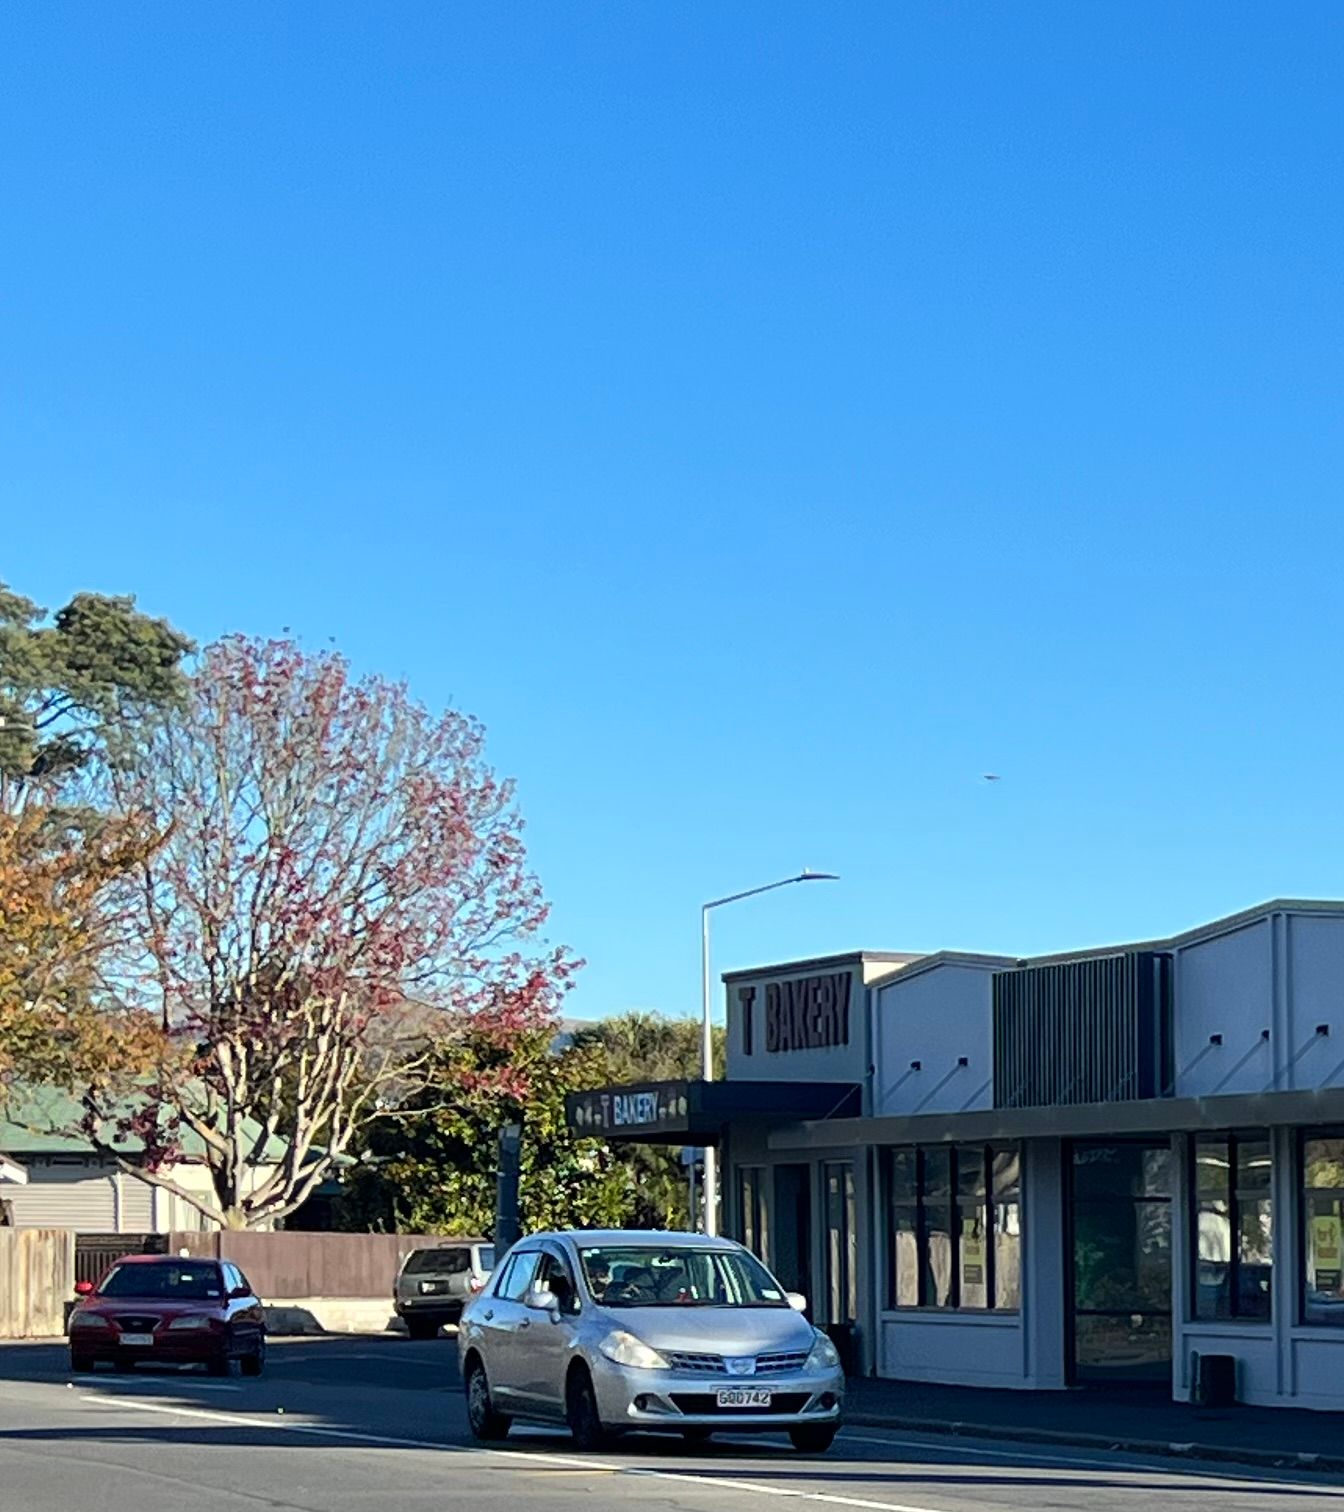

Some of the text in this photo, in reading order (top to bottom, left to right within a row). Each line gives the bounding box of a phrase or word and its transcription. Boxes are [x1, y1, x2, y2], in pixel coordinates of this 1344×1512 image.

[738, 971, 852, 1056] T BAKERY
[614, 1091, 659, 1126] BAKERY
